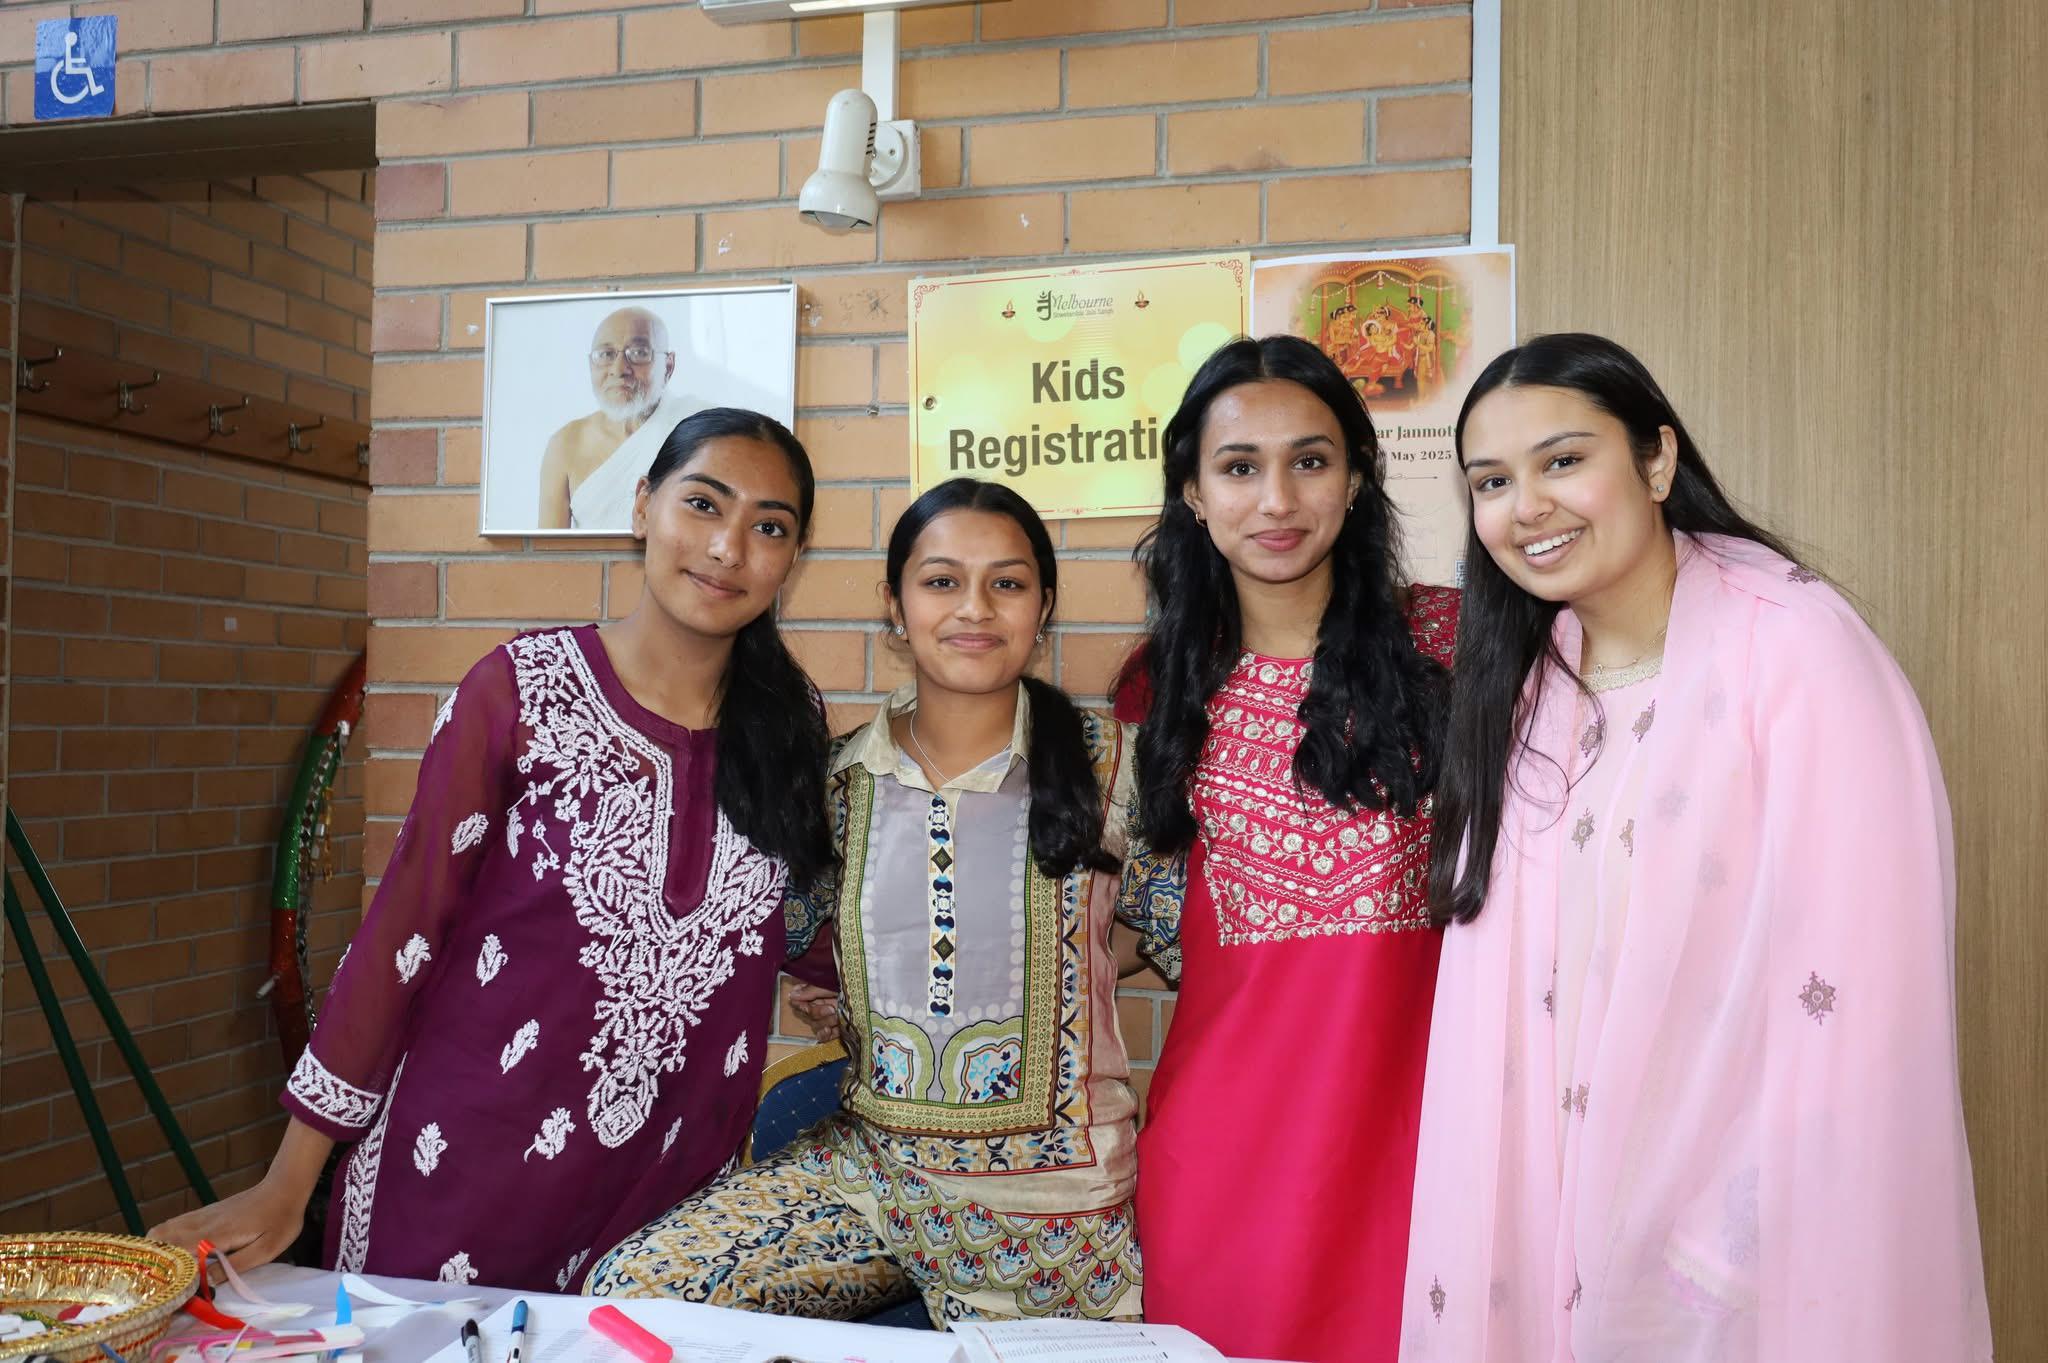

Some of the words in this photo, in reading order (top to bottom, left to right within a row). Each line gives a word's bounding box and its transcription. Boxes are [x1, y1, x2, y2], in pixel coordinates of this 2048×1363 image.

[1052, 294, 1113, 310] Melbourne
[1032, 359, 1125, 403] Kids
[950, 417, 1162, 477] Registrati
[1391, 451, 1416, 462] May
[1420, 450, 1452, 460] 2025
